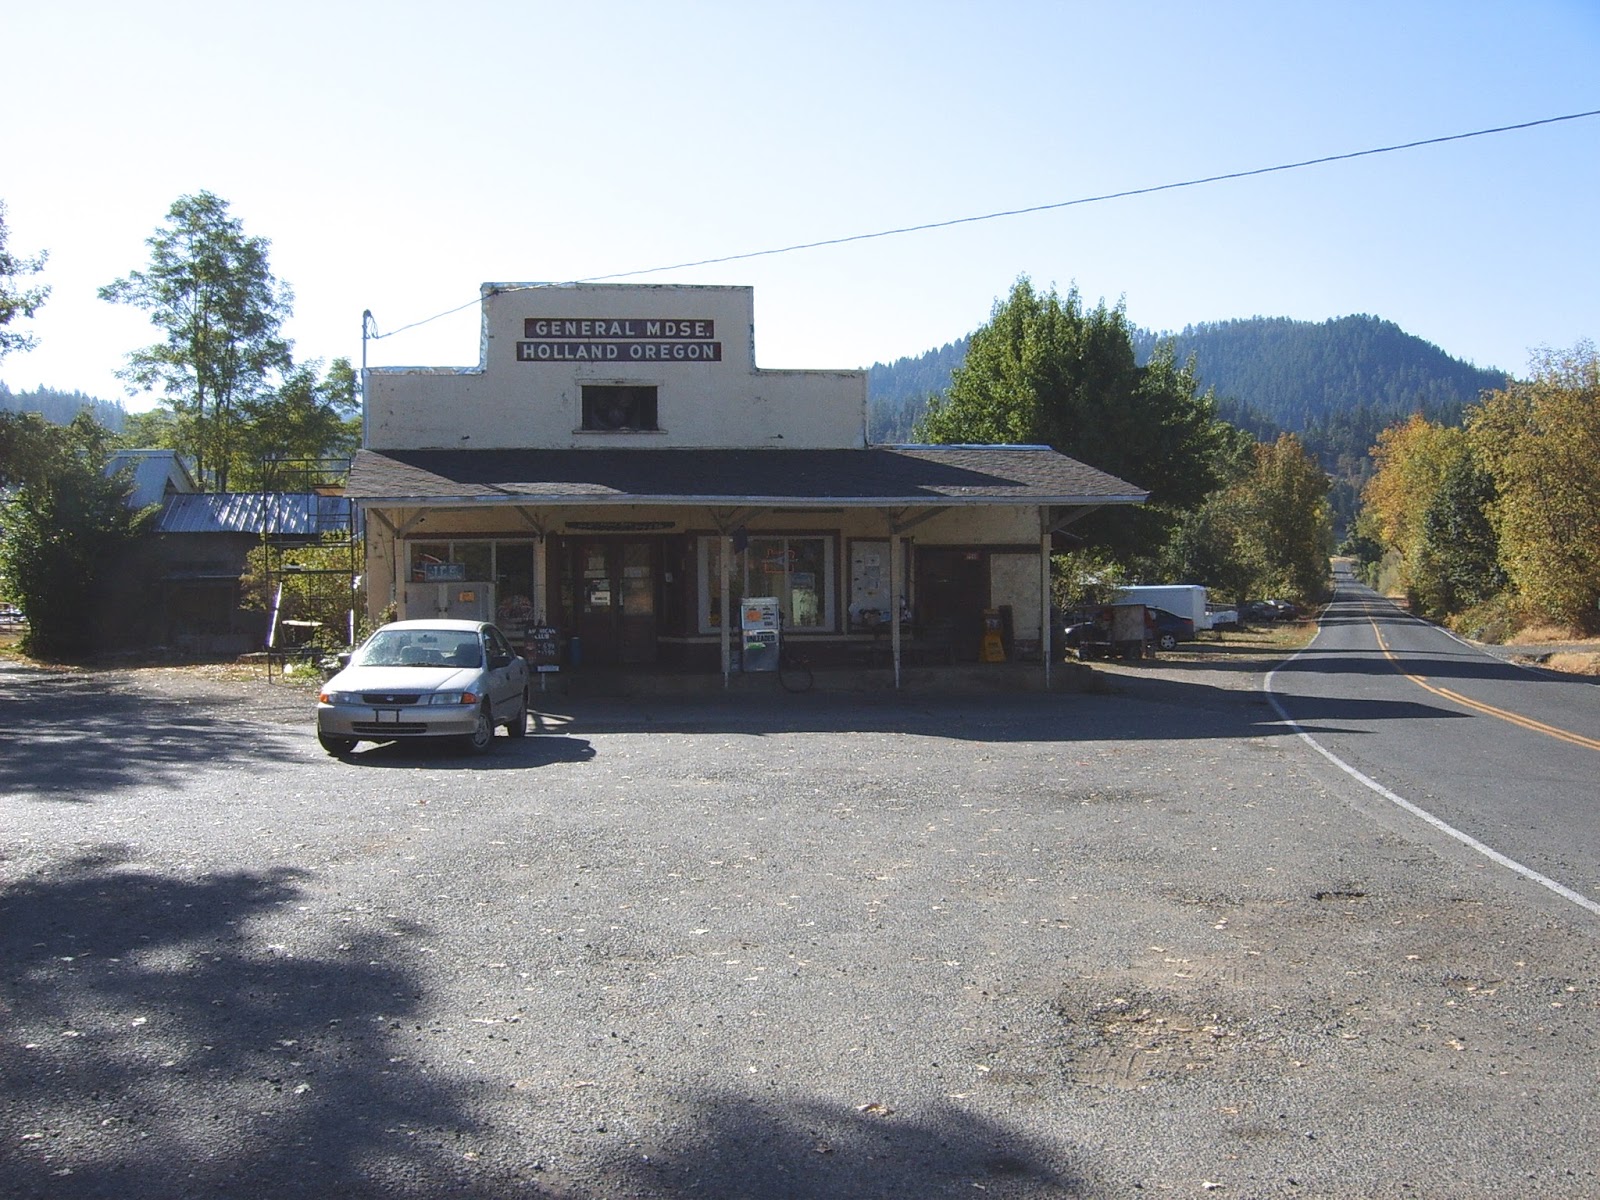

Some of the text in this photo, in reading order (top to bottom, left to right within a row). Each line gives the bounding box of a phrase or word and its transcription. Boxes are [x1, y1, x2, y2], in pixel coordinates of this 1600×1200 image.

[535, 321, 710, 336] GENERAL MDSE.
[522, 344, 715, 359] HOLLAND OREGON
[746, 635, 776, 643] UNLEADED
